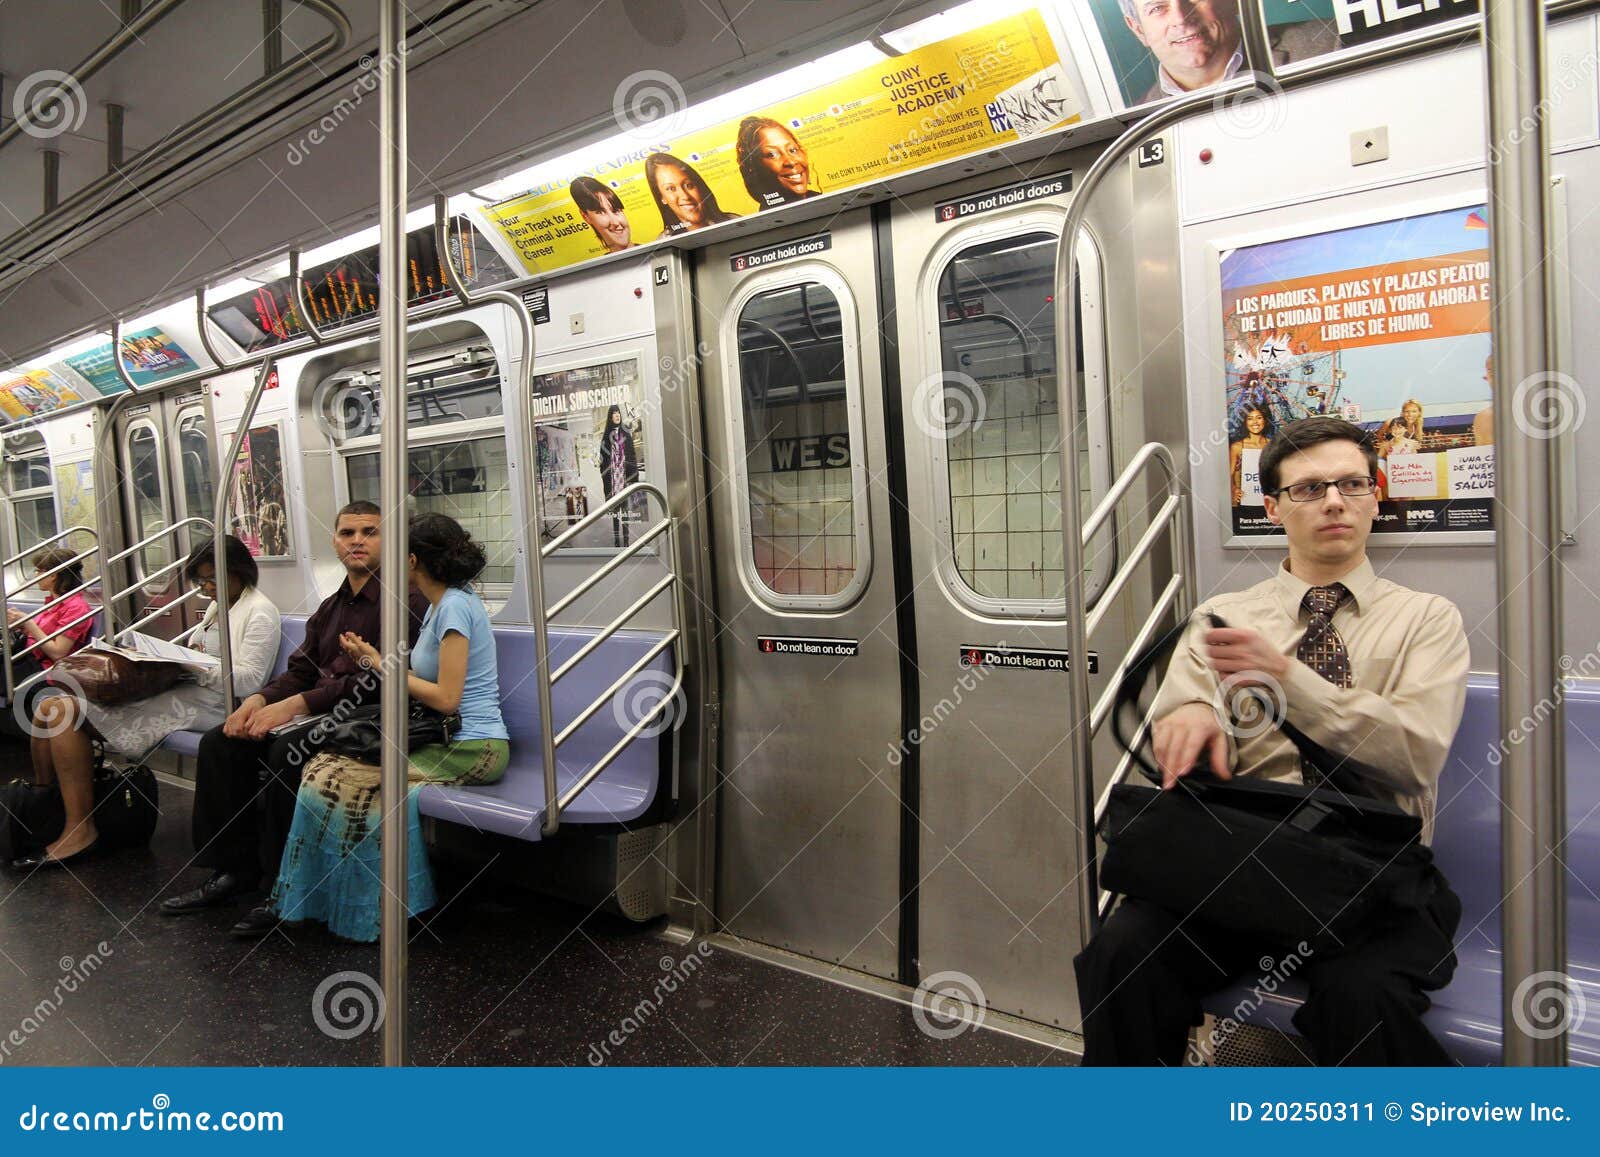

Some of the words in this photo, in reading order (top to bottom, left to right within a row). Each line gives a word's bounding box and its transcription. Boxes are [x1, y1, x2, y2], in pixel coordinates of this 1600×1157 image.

[881, 65, 922, 88] CUNY
[890, 72, 952, 102] JUSTICE
[897, 83, 967, 117] ACADEMY
[827, 171, 840, 181] Text
[840, 166, 855, 178] CUNY
[966, 130, 978, 142] aid
[1139, 143, 1163, 164] L3
[960, 202, 975, 216] Do
[978, 198, 998, 211] not
[999, 190, 1025, 206] hold
[1027, 181, 1063, 199] doors
[497, 214, 520, 229] Your
[507, 225, 529, 240] New
[526, 217, 553, 234] Track
[554, 213, 565, 227] to
[566, 211, 574, 222] a
[515, 230, 555, 250] Criminal
[555, 220, 590, 240] Justice
[523, 245, 554, 261] Career
[749, 255, 760, 267] Do
[762, 252, 777, 263] not
[778, 246, 797, 261] hold
[798, 240, 825, 256] doors
[655, 269, 668, 284] L4
[1236, 296, 1259, 315] LOS
[1261, 287, 1320, 311] PARQUES,
[1322, 279, 1370, 302] PLAYAS
[1372, 277, 1382, 294] Y
[1384, 269, 1437, 293] PLAZAS
[1241, 315, 1257, 333] DE
[1259, 313, 1275, 330] LA
[1276, 306, 1322, 328] CIUDAD
[1324, 303, 1341, 322] DE
[1343, 297, 1387, 319] NUEVA
[1388, 291, 1427, 313] YORK
[1428, 285, 1478, 308] AHORA
[1321, 320, 1365, 341] LIBRES
[1368, 317, 1386, 336] DE
[1388, 312, 1433, 333] HUMO.
[532, 394, 569, 418] DIGITAL
[773, 435, 850, 470] WES
[1453, 464, 1465, 472] DE
[1467, 462, 1495, 471] NUEV
[1406, 509, 1435, 520] NYC
[776, 641, 788, 653] Do
[789, 642, 803, 653] not
[804, 642, 821, 654] lean
[822, 645, 834, 655] on
[835, 644, 856, 656] door
[985, 652, 1001, 666] Do
[1003, 654, 1021, 667] not
[1023, 655, 1047, 668] lean
[1048, 657, 1063, 669] on
